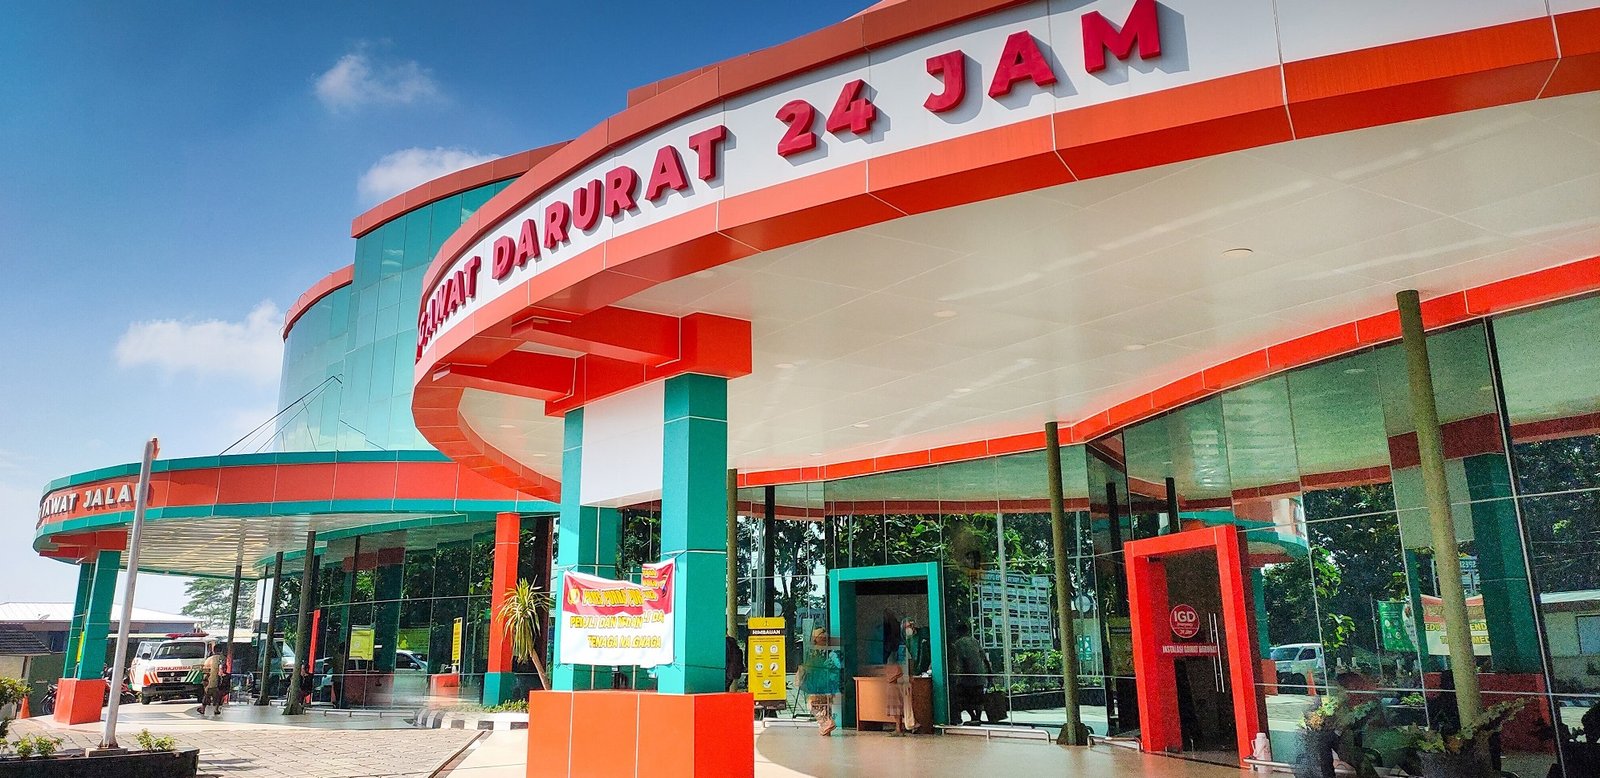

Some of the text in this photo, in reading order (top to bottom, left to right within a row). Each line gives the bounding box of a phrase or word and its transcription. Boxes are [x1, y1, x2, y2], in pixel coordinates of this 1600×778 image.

[492, 125, 727, 280] DARURAT
[776, 79, 876, 157] 24
[923, 0, 1161, 112] JAM
[38, 493, 77, 519] AWAT
[1174, 611, 1196, 622] IGD
